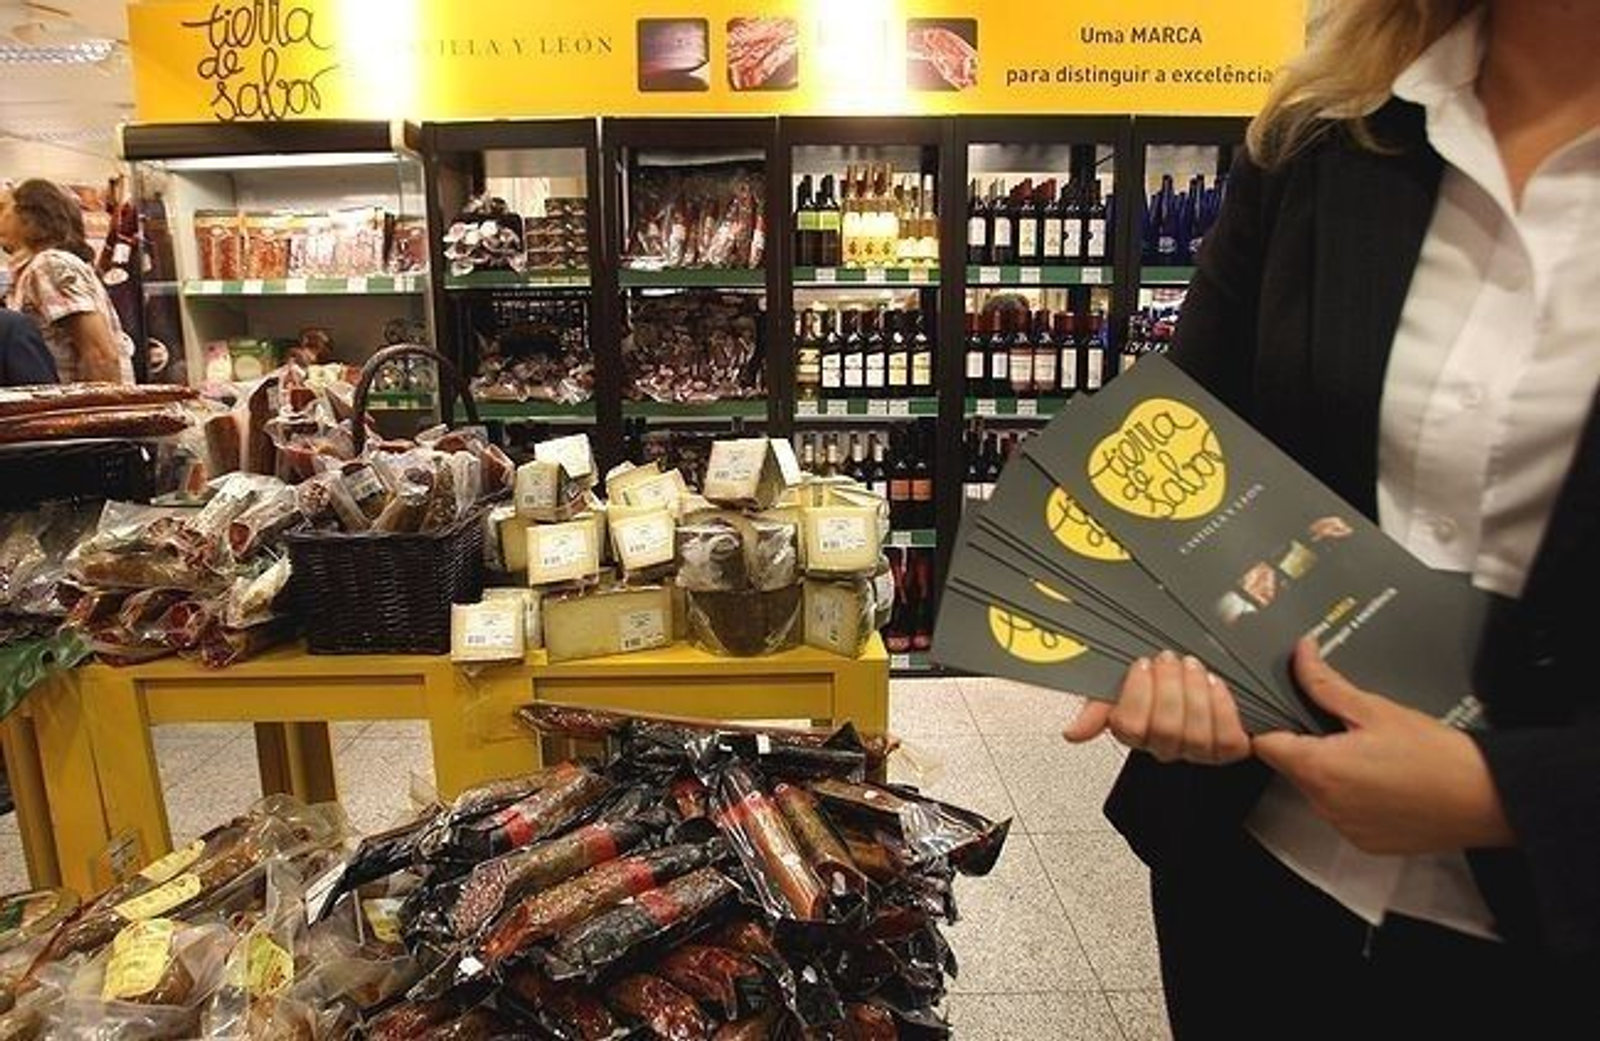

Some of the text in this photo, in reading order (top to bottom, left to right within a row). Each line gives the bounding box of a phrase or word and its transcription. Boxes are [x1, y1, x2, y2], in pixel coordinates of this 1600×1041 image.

[181, 0, 334, 50] tierra
[1081, 26, 1202, 44] Uma MARCA
[513, 37, 527, 55] Y
[198, 50, 245, 80] de
[1006, 63, 1274, 87] para distinguir a excelência
[210, 48, 340, 122] sabor
[1088, 411, 1200, 480] tierra
[1122, 469, 1154, 501] de
[1144, 426, 1225, 518] sabor
